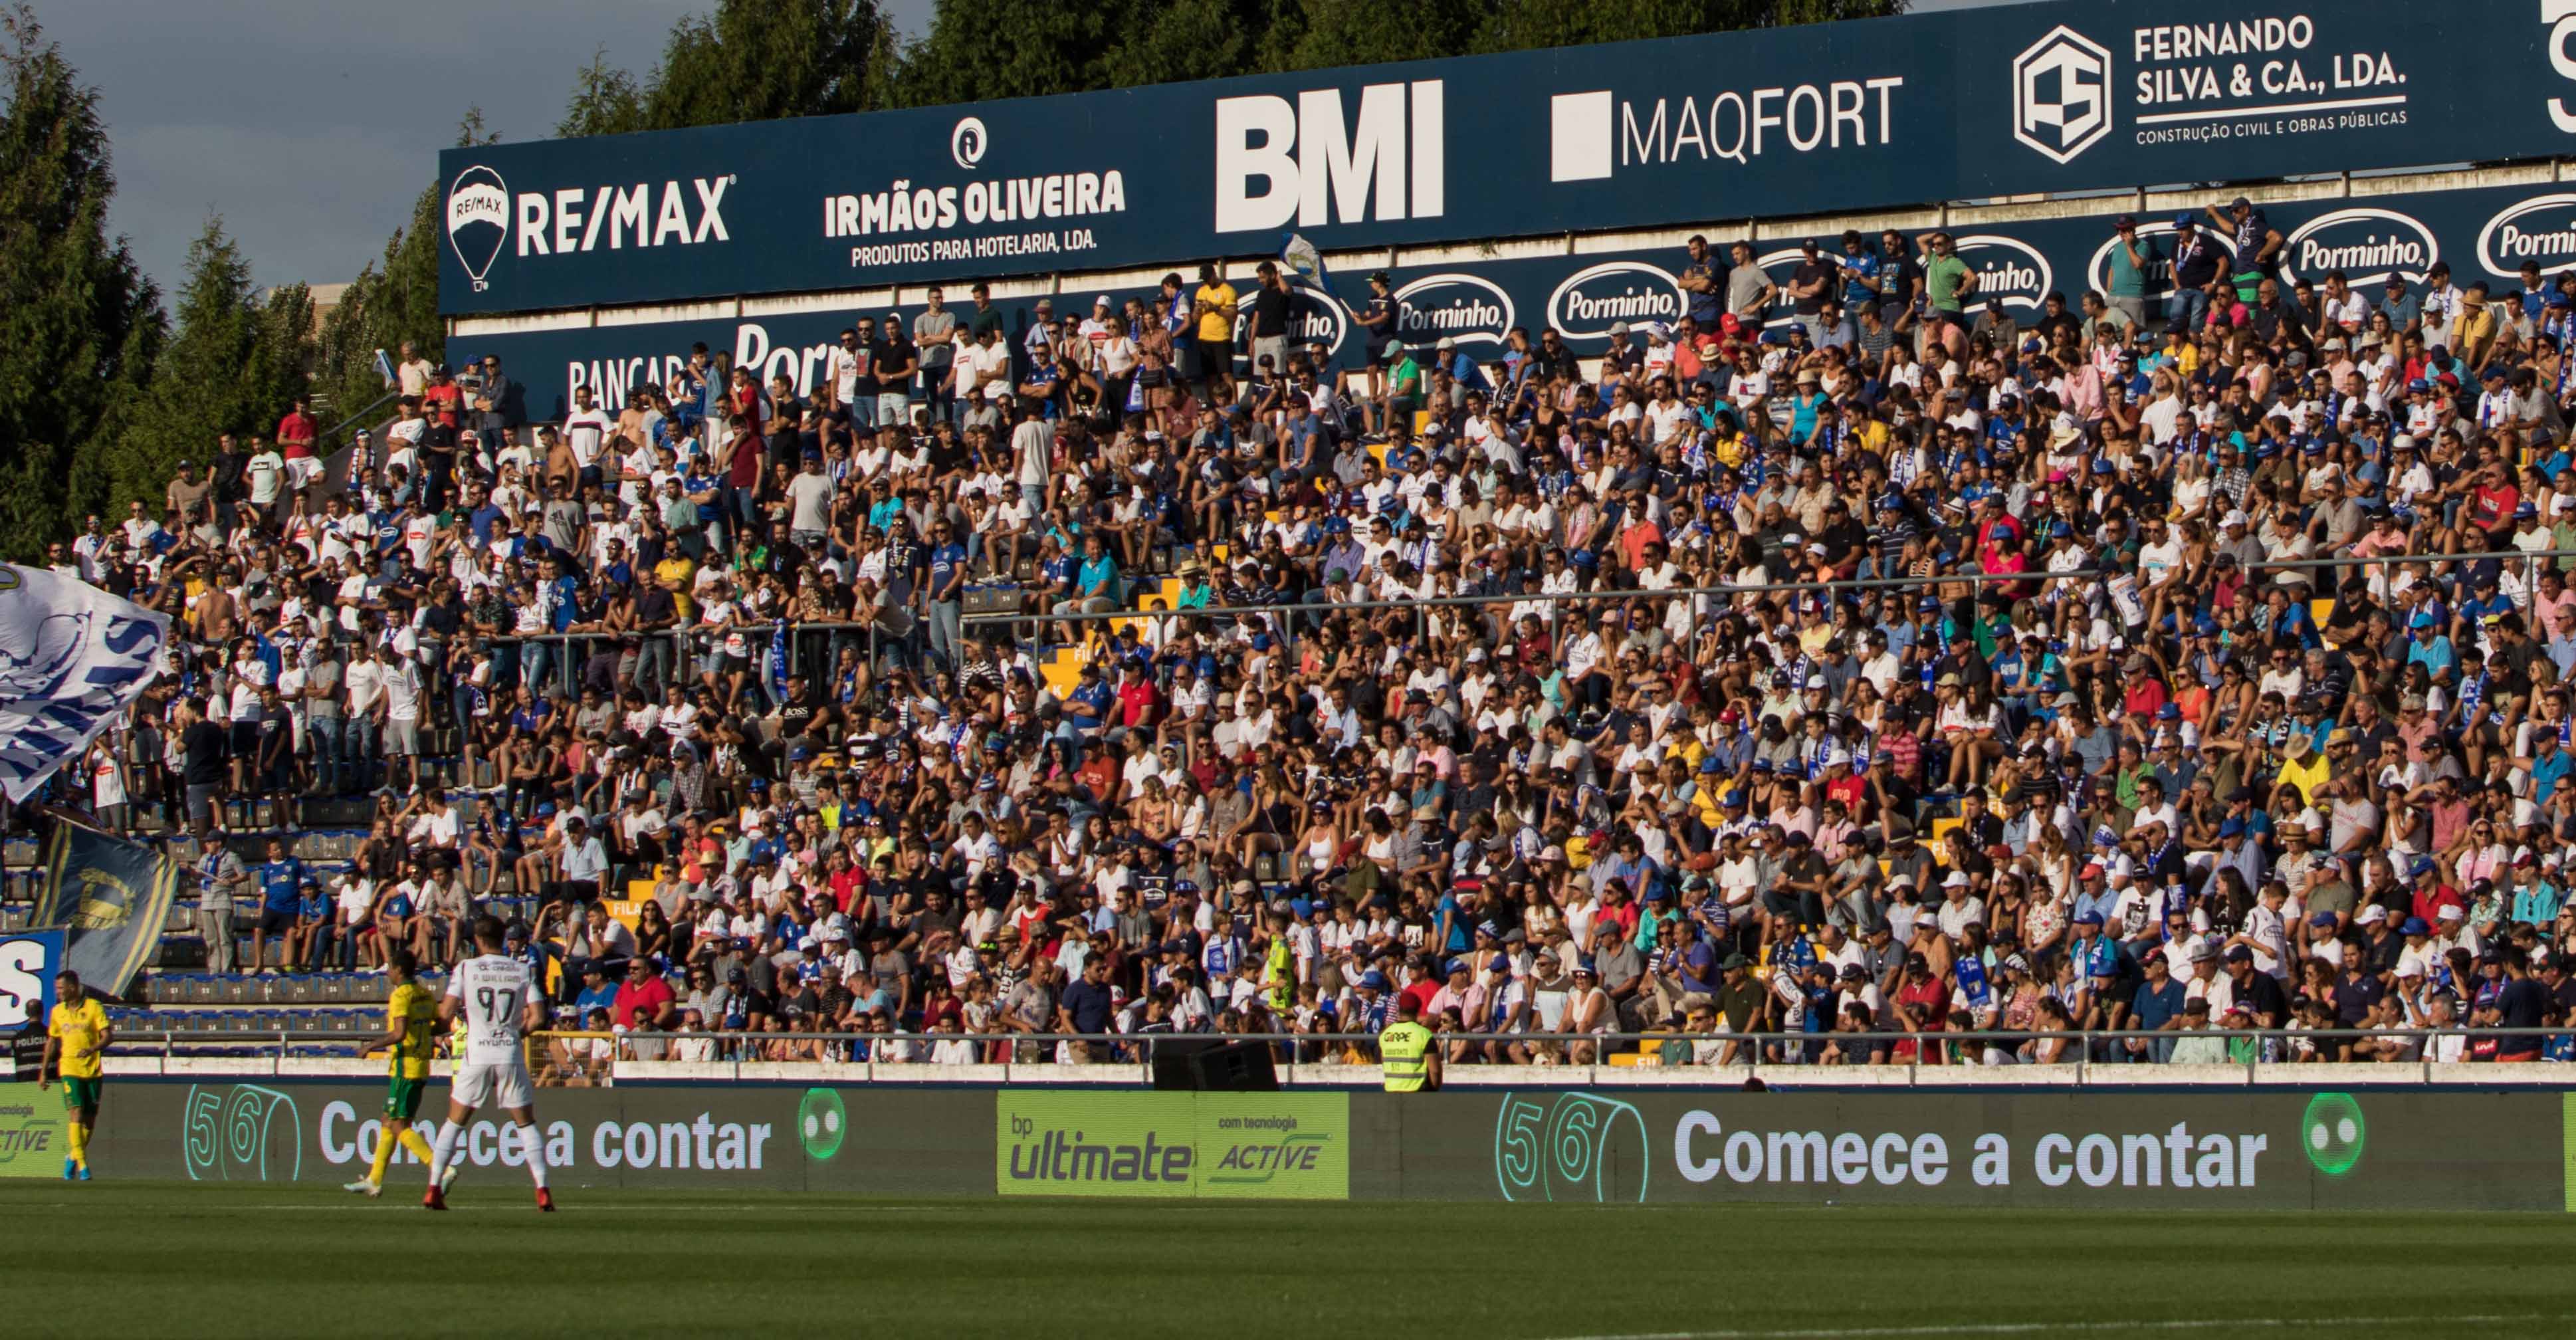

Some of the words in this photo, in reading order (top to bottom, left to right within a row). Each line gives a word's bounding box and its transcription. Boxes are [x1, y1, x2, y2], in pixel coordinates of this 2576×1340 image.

[2135, 15, 2313, 62] FERNANDO
[2136, 64, 2221, 104] SILVA
[2229, 63, 2253, 97] &
[2261, 59, 2325, 95] CA.,
[2334, 52, 2407, 88] LDA.
[1622, 76, 1903, 166] MAQFORT
[2136, 123, 2230, 145] CONSTRUÇÃO
[2234, 122, 2271, 137] CIVIL
[2276, 120, 2284, 134] E
[2288, 116, 2335, 133] OBRAS
[2339, 110, 2407, 128] PÚBLICAS
[1216, 80, 1443, 233] BMI
[456, 196, 502, 218] RE/MAX
[518, 175, 730, 257] RE/MAX
[825, 179, 957, 237] IRMÃOS
[964, 170, 1126, 224] OLIVEIRA
[852, 241, 930, 268] PRODUTOS
[933, 239, 972, 261] PARA
[975, 232, 1061, 258] HOTELARIA,
[1064, 229, 1097, 251] LDA.
[569, 355, 691, 411] BANCAD
[785, 707, 808, 716] BOSS
[478, 986, 516, 1024] 97
[545, 1121, 574, 1167] a
[593, 1111, 772, 1170] contar
[1012, 1113, 1033, 1139] bp
[1218, 1117, 1242, 1129] com
[1243, 1115, 1297, 1132] tecnologia
[1010, 1130, 1193, 1182] ultimate
[1218, 1145, 1322, 1171] ACTIVE
[1675, 1109, 1949, 1186] Comece
[1972, 1133, 2010, 1186] a
[2034, 1121, 2267, 1188] contar
